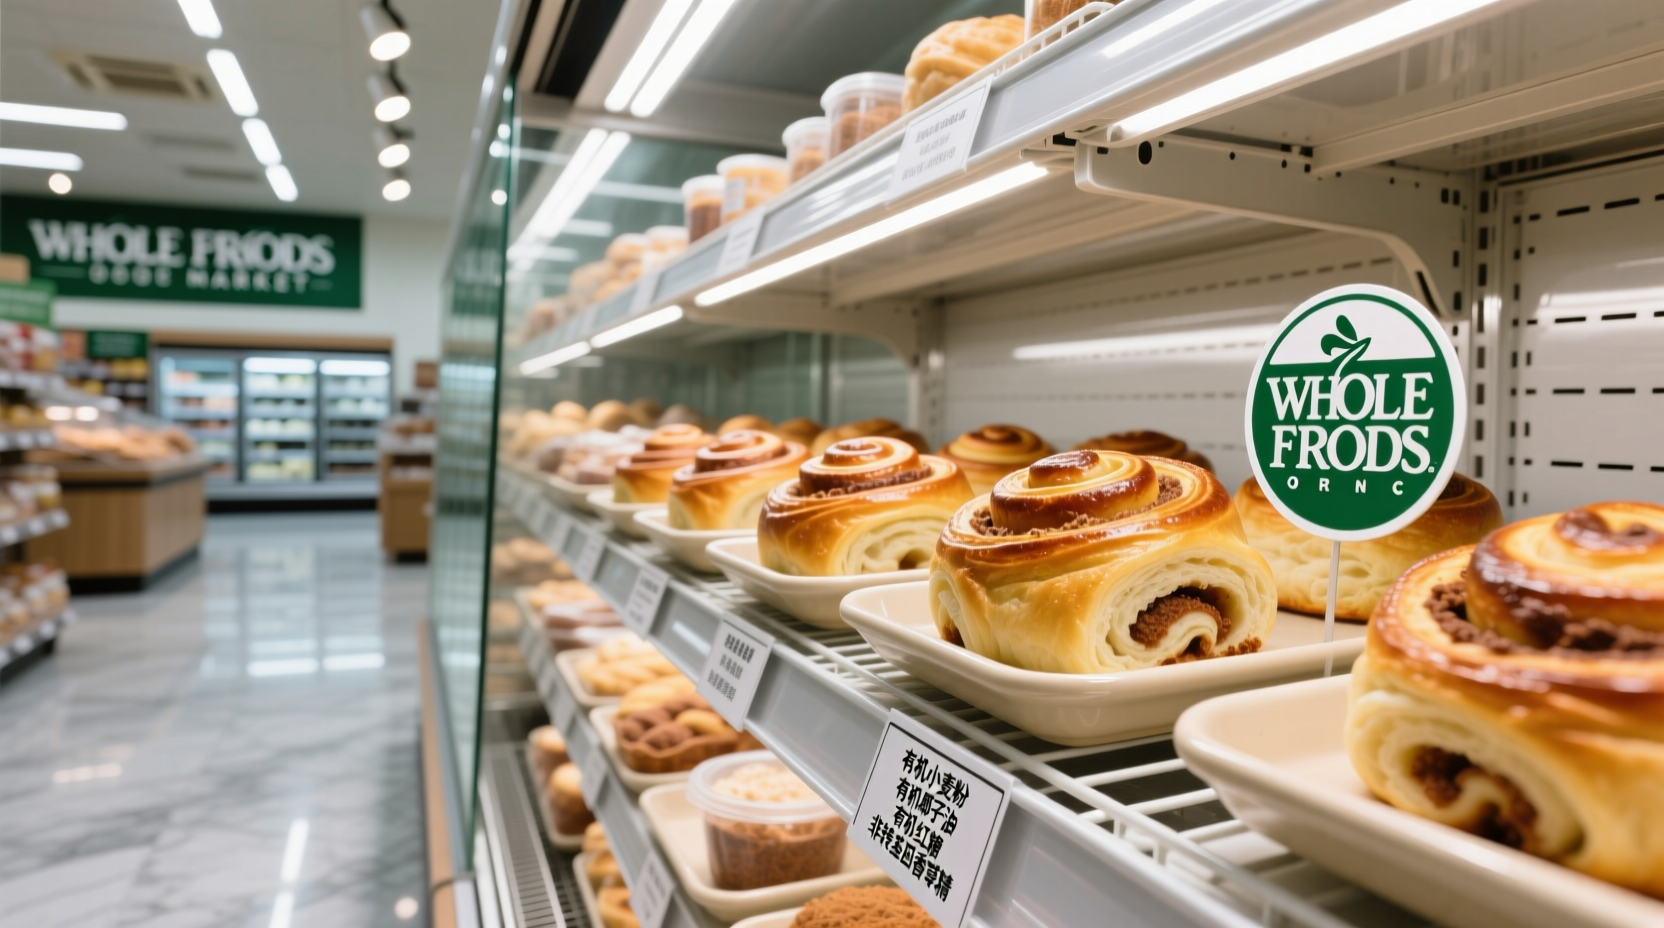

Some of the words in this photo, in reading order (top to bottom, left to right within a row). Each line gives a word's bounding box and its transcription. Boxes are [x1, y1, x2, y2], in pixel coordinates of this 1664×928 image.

[28, 219, 186, 268] WHOLE
[186, 268, 310, 294] MARKET
[1266, 372, 1434, 421] WHOLE
[902, 748, 969, 808] 有机小麦粉
